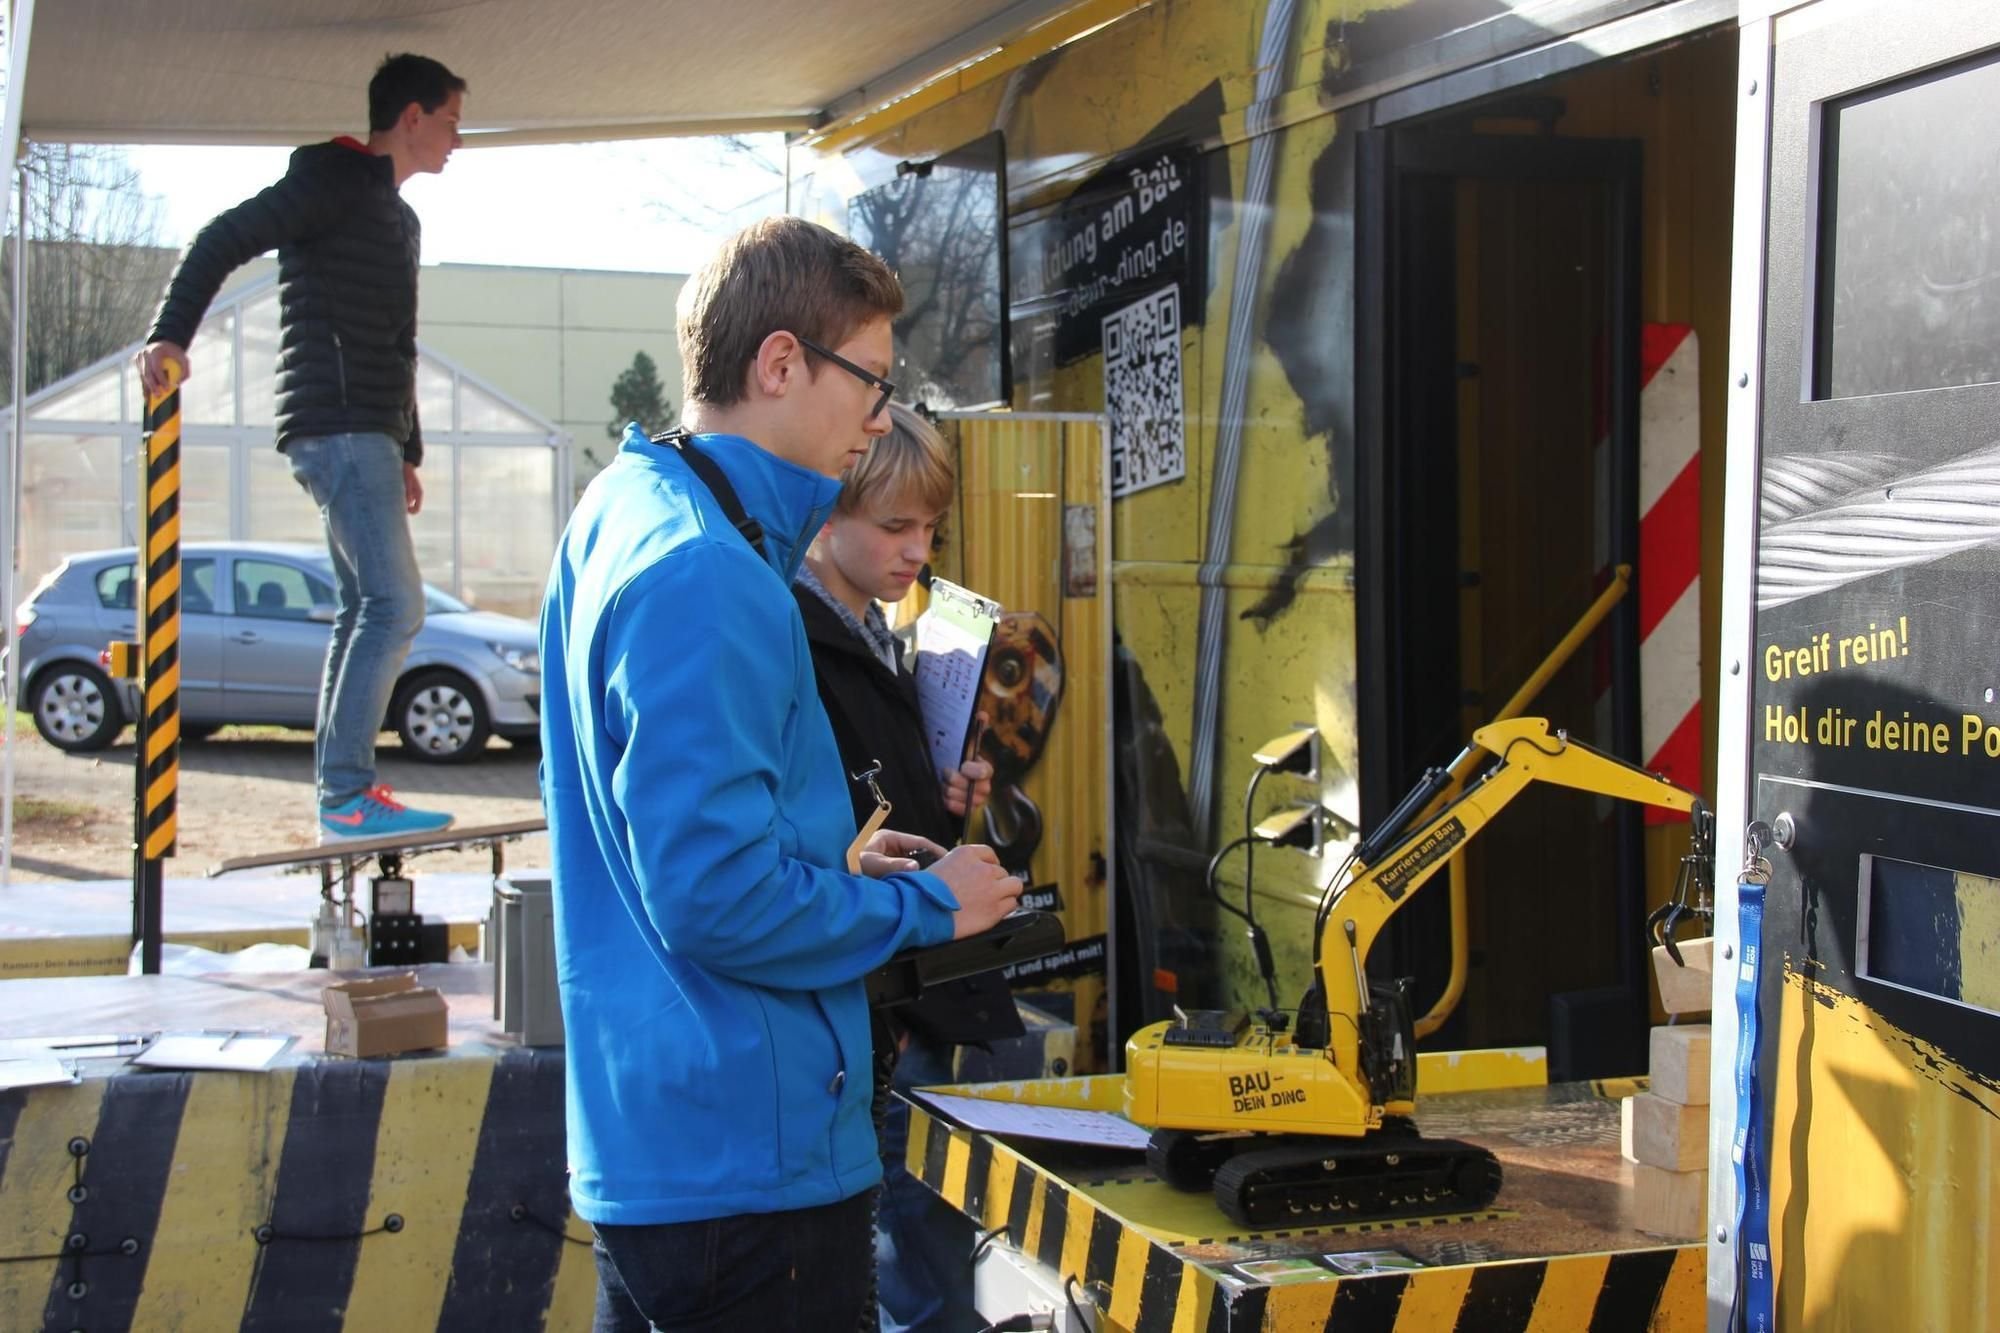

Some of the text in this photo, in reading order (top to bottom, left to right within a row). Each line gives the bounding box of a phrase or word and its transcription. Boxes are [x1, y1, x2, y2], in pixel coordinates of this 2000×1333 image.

[1102, 195, 1134, 242] am
[1764, 615, 1909, 682] Greif rein!
[1764, 704, 1809, 744] Hol
[1817, 707, 1857, 748] dir
[1865, 710, 1950, 755] deine
[1380, 821, 1455, 886] Karriere am Bau
[1022, 892, 1054, 909] Bau
[1019, 961, 1042, 975] und
[1045, 951, 1075, 970] spiel
[1076, 943, 1104, 960] mit!
[1229, 1071, 1285, 1097] BAU-
[1233, 1088, 1307, 1114] DEIN DING
